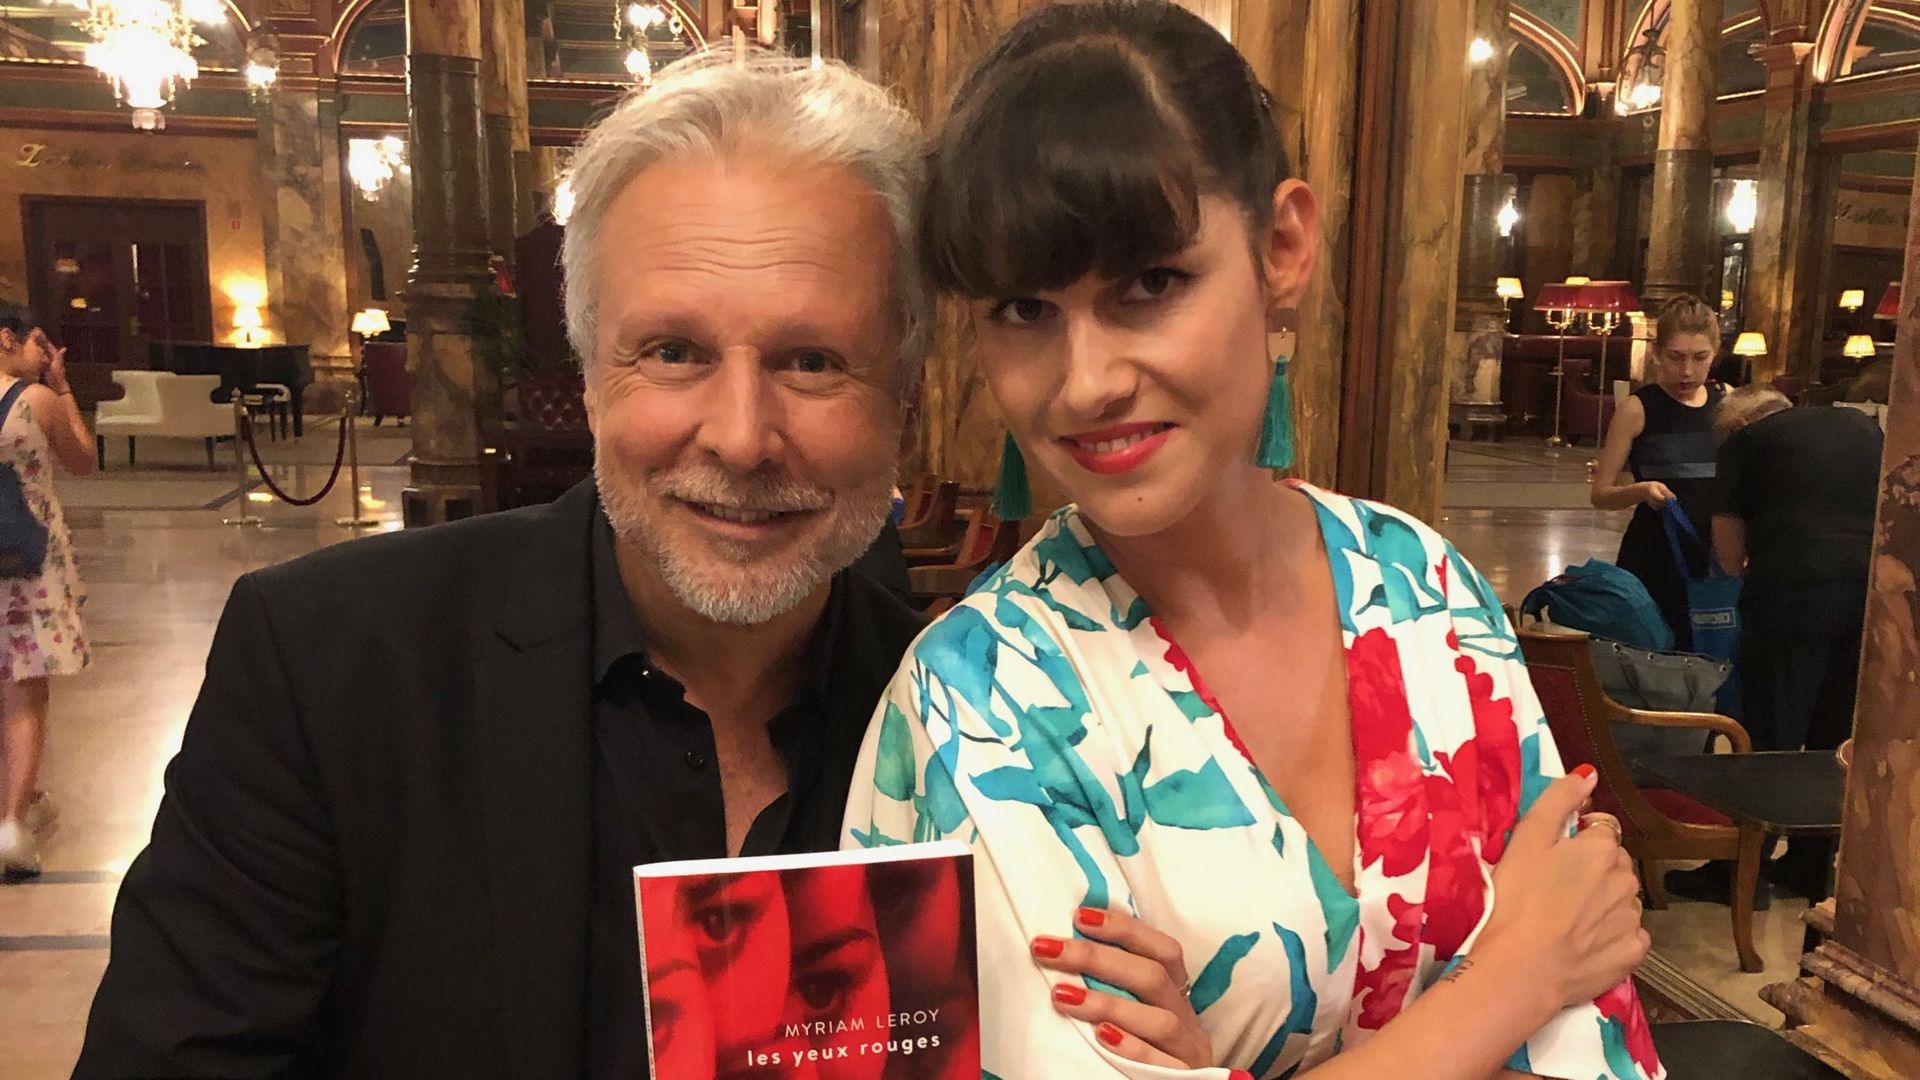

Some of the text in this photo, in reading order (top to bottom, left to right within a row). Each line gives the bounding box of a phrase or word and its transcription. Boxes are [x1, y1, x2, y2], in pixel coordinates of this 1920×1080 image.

[784, 1008, 940, 1038] MYRIAM LEROY
[747, 1034, 941, 1068] les yeux rouges
